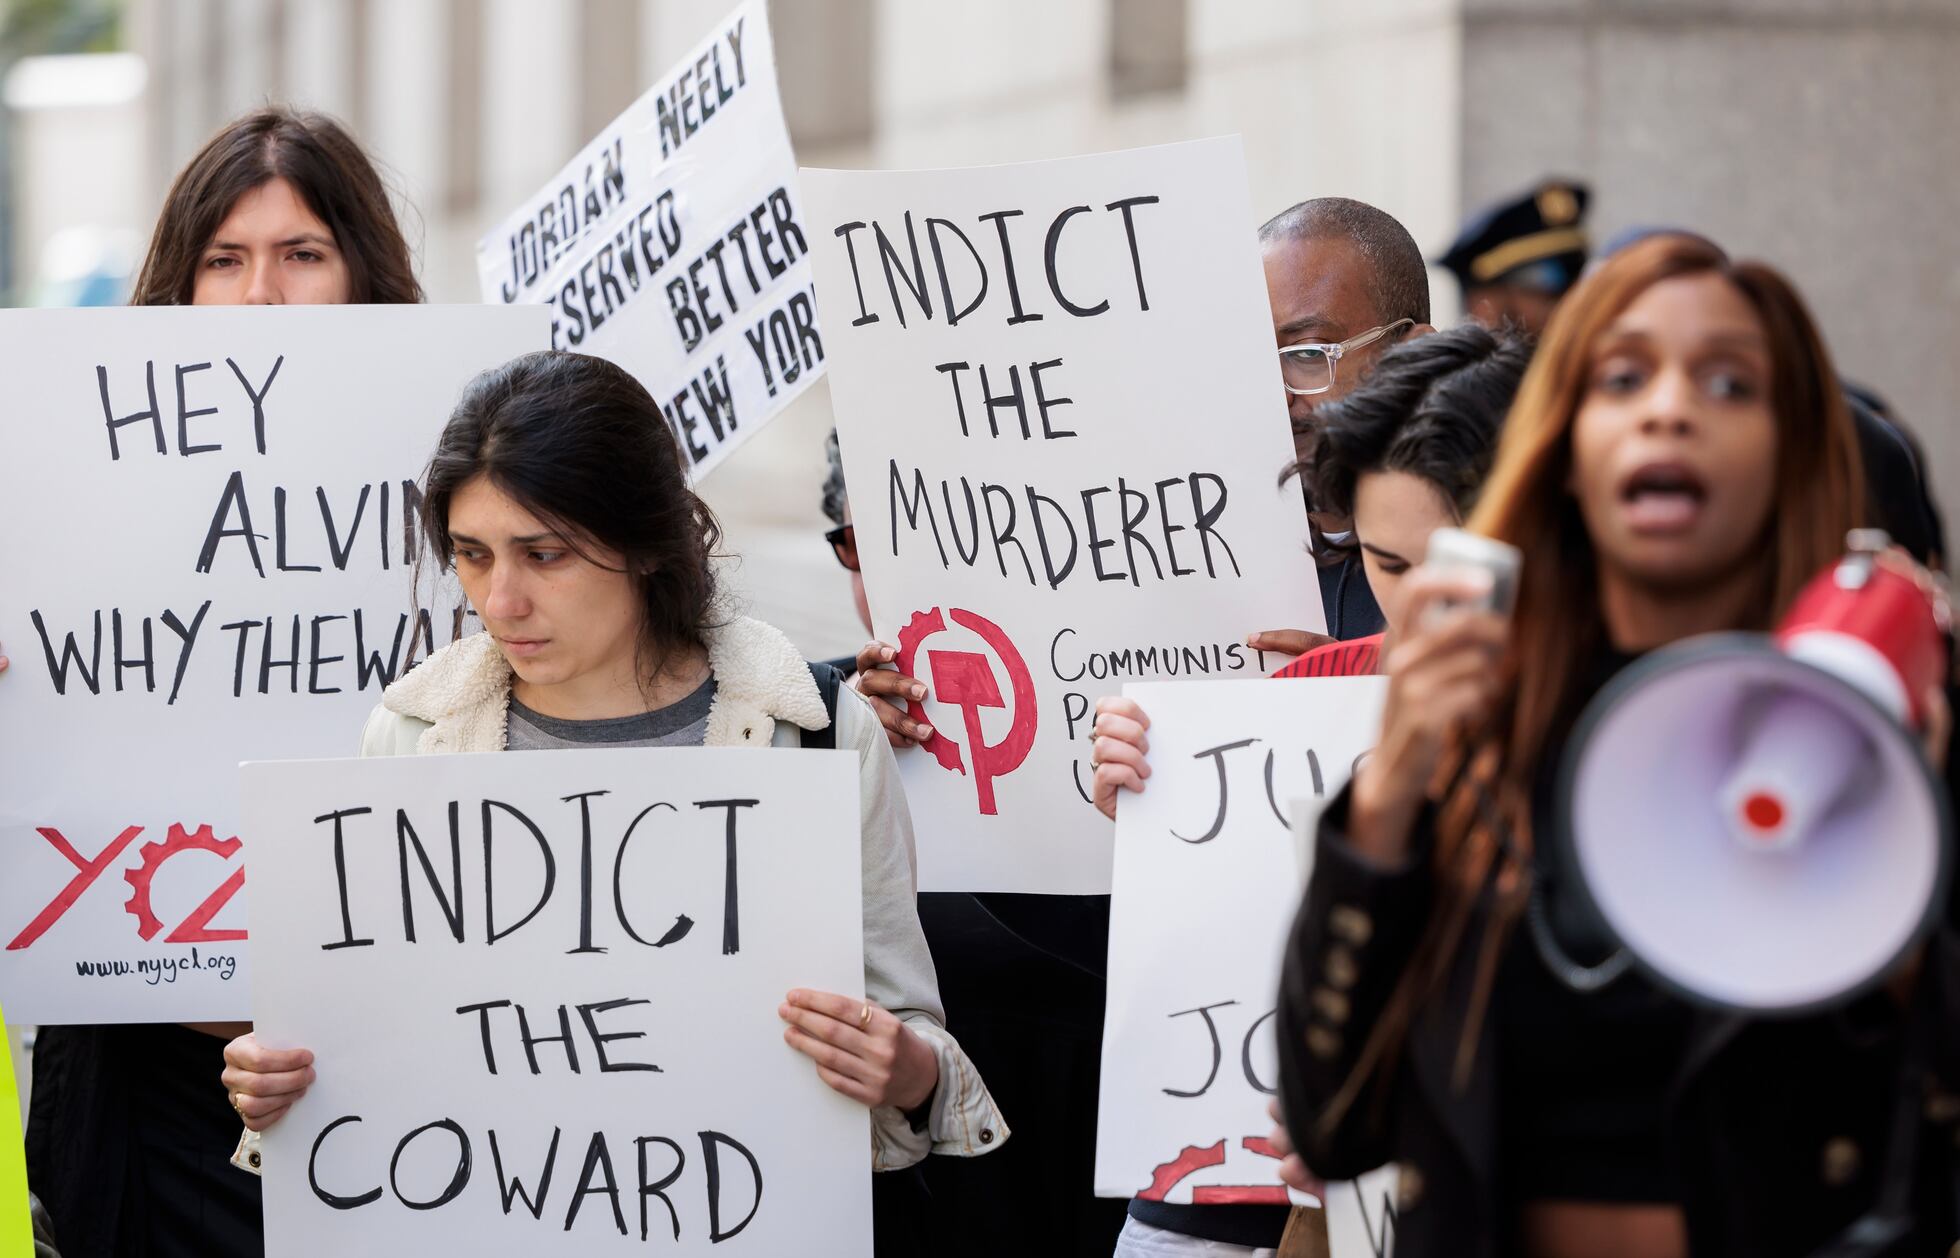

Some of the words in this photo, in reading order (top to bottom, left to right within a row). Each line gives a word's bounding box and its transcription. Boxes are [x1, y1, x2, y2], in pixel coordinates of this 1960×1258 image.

[502, 137, 627, 303] JORDAN
[656, 16, 746, 160] NEELY
[545, 188, 682, 353] ESERVED
[665, 186, 808, 355] BETTER
[834, 196, 1160, 329] INDICT
[745, 282, 825, 398] YOR
[935, 358, 1078, 440] THE
[96, 355, 285, 460] HEY
[196, 471, 447, 578] ALVIN
[889, 458, 1241, 590] MURDERER
[30, 601, 212, 705] WHY
[314, 790, 761, 956] INDICT
[76, 947, 236, 985] www.nyycl.org
[456, 997, 664, 1075] THE
[308, 1115, 763, 1244] COWARD
